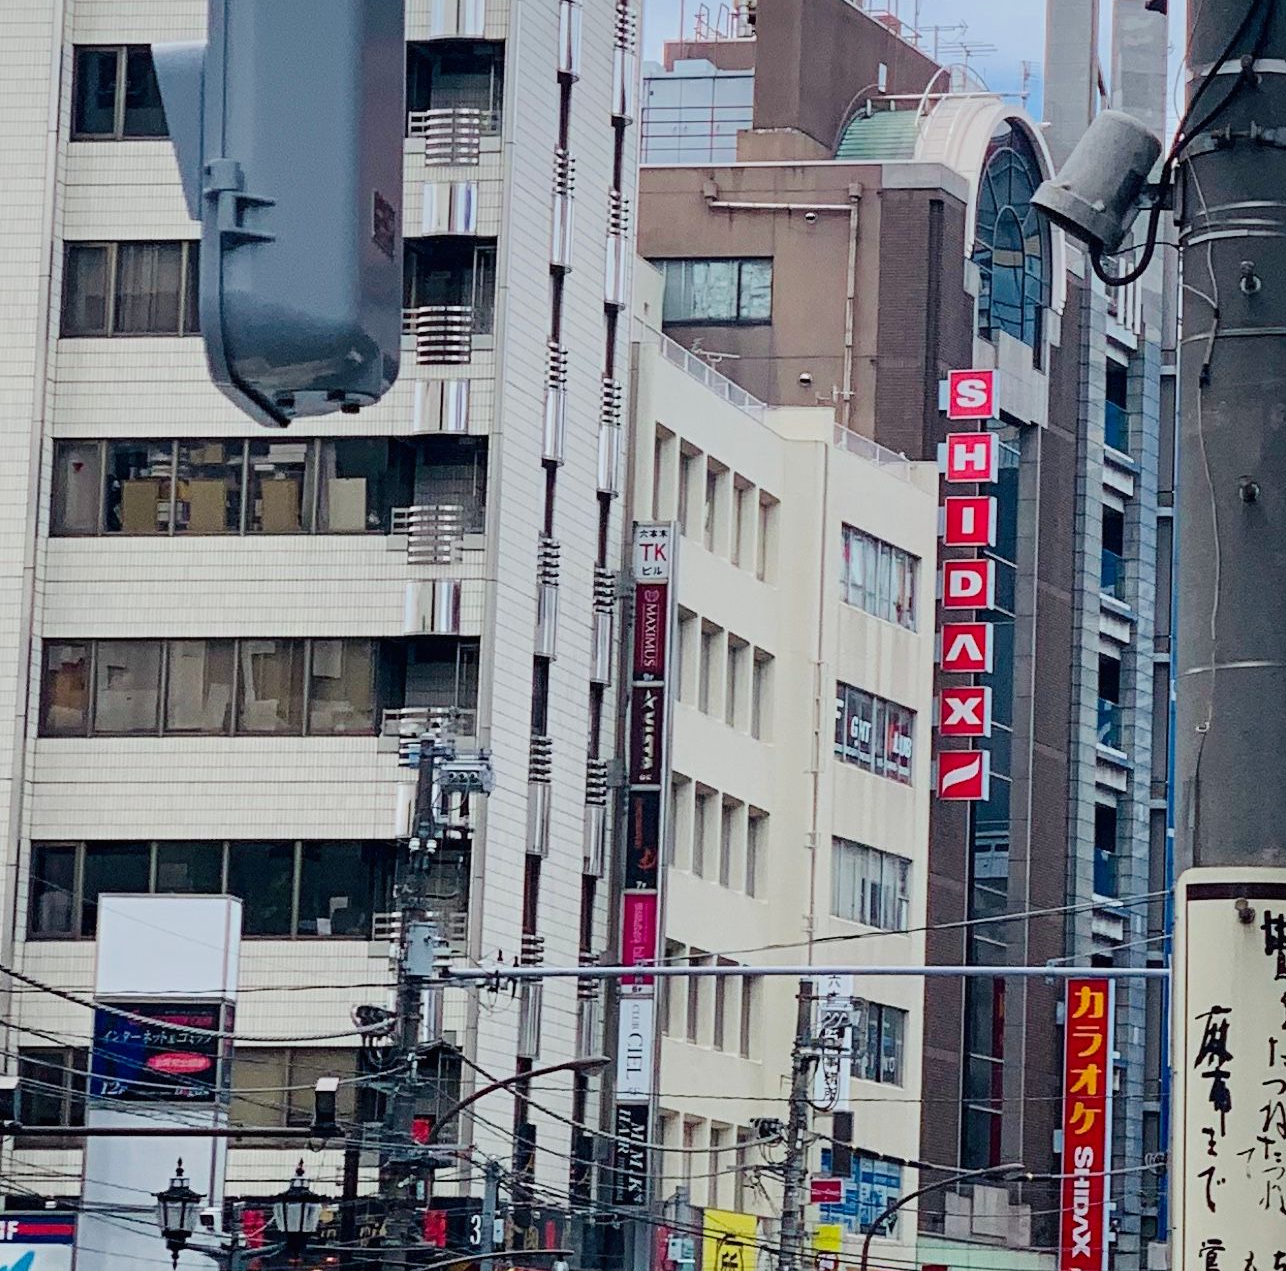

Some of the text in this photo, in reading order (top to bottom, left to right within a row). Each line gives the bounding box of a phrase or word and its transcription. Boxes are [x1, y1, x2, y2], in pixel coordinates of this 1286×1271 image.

[639, 542, 667, 562] TK
[835, 697, 873, 744] FGHT
[1068, 985, 1106, 1136] カラオケ
[1071, 1144, 1095, 1260] SHIDAX
